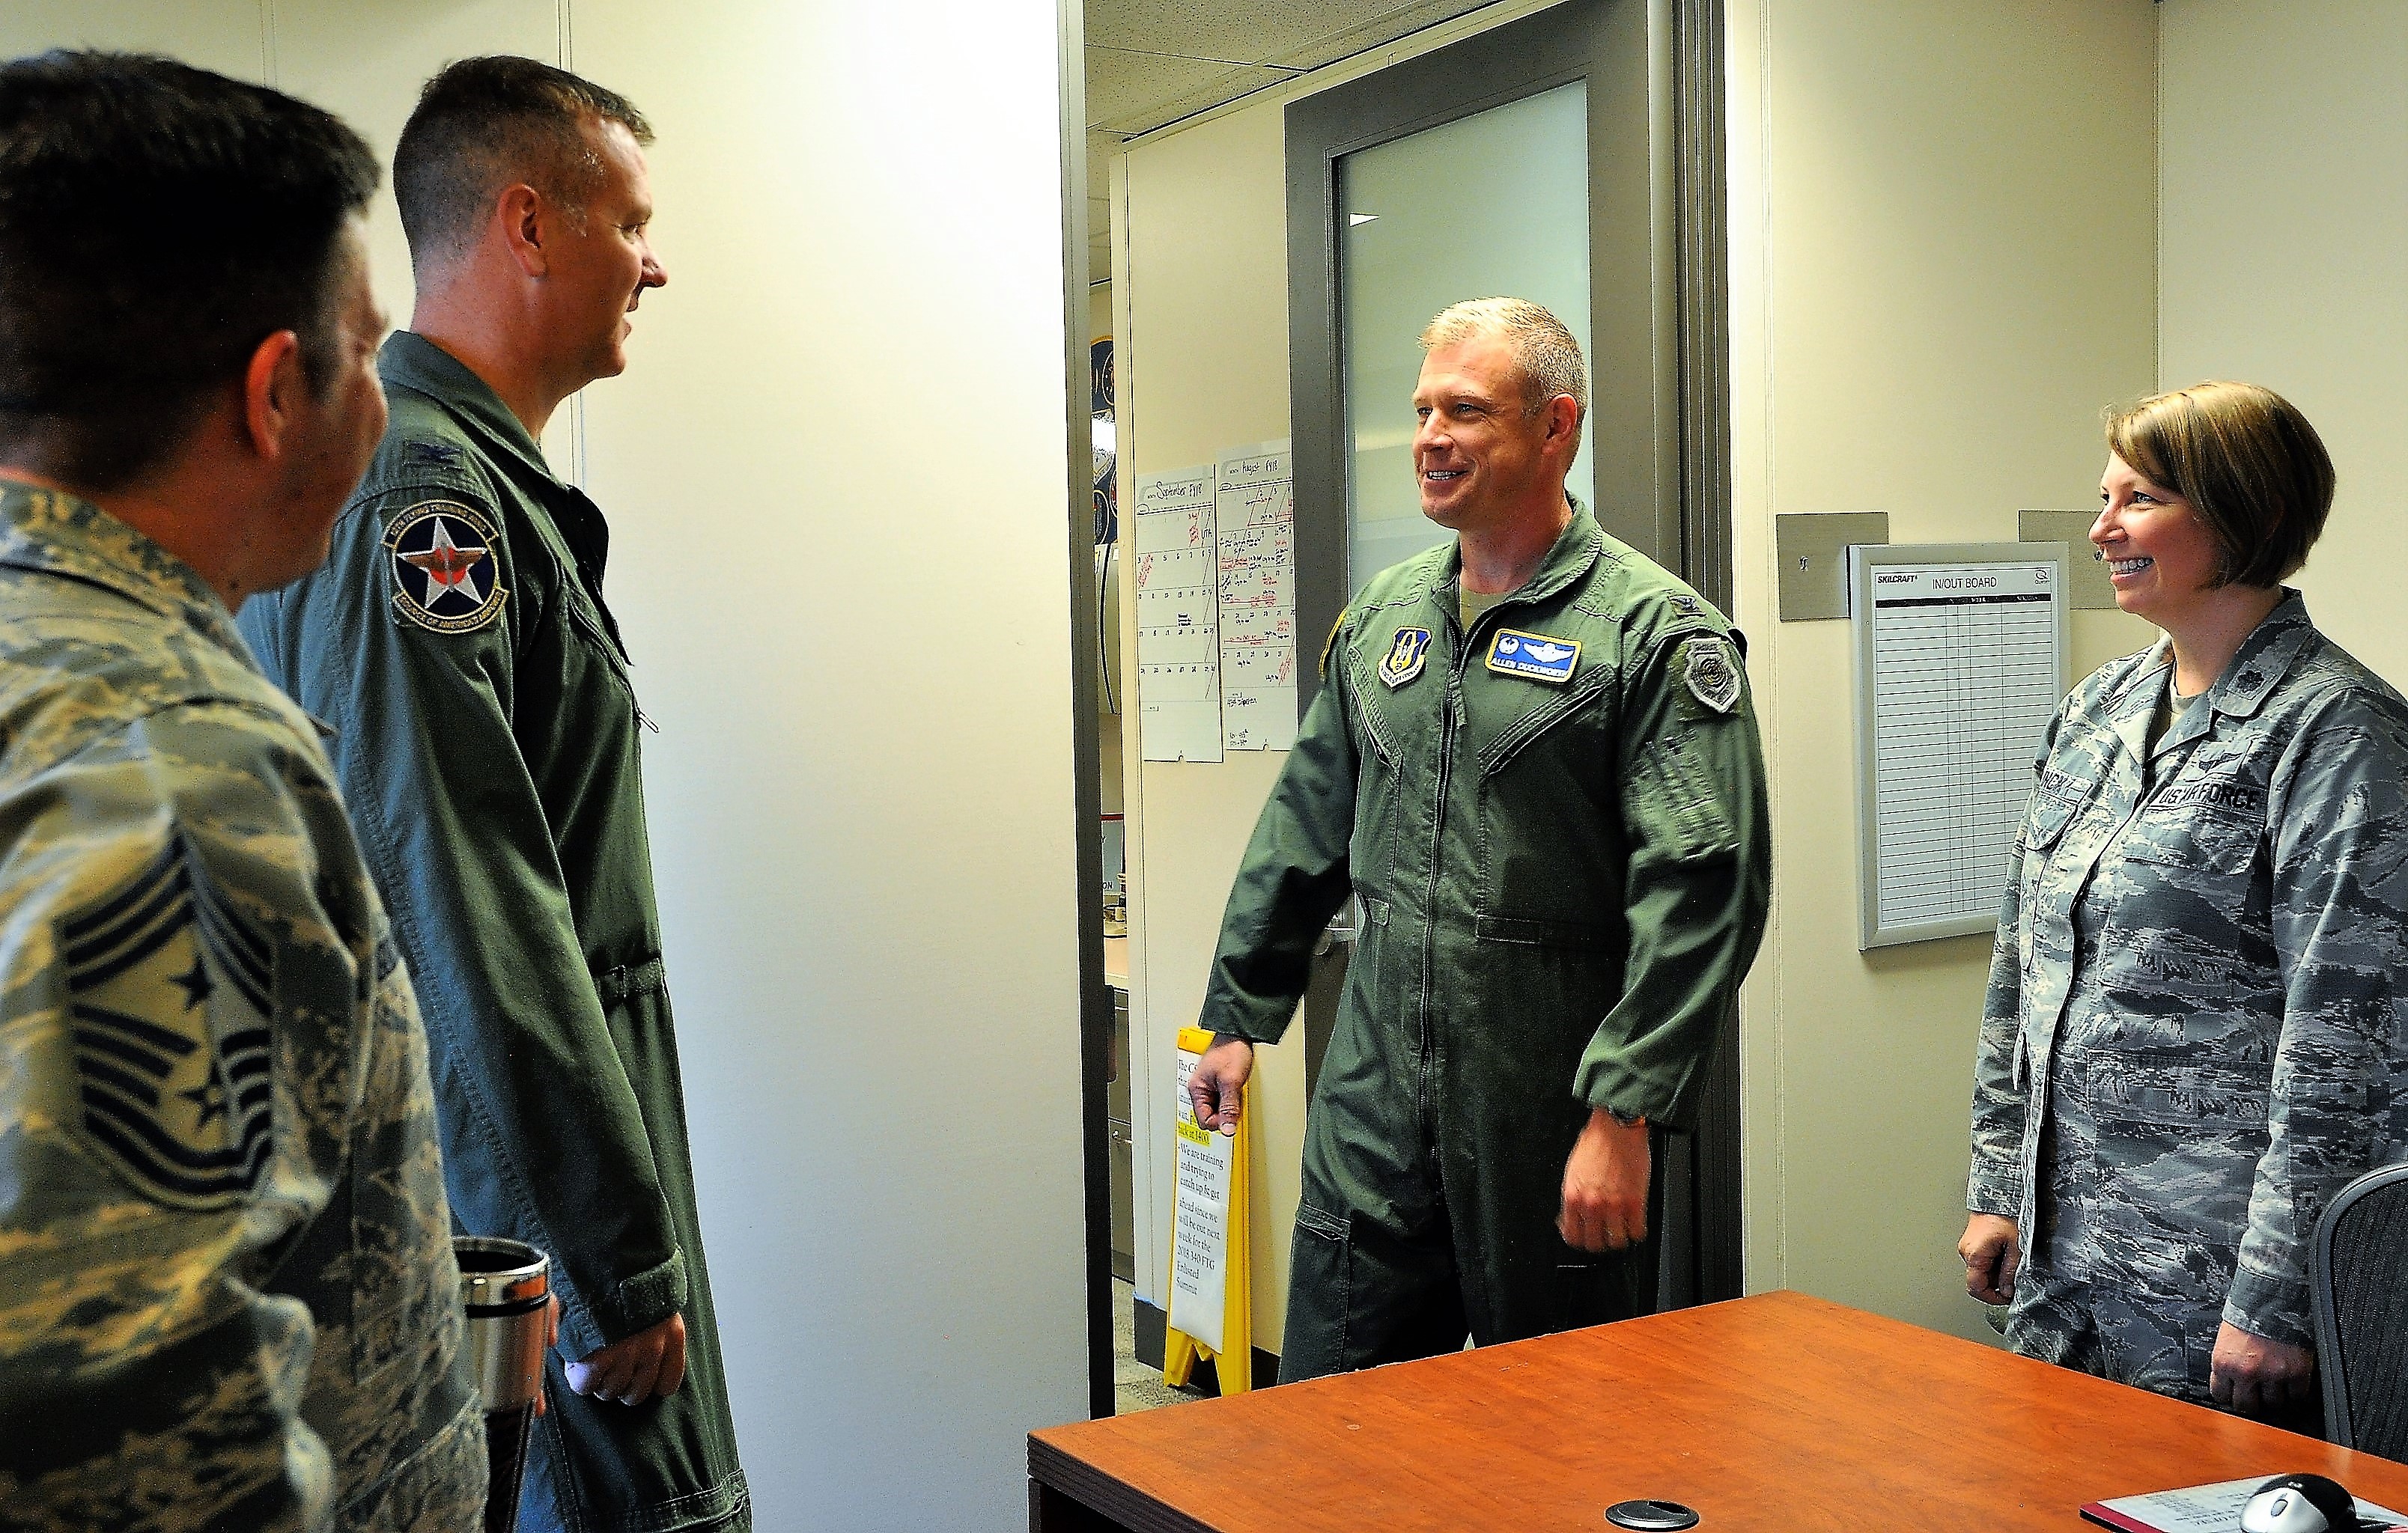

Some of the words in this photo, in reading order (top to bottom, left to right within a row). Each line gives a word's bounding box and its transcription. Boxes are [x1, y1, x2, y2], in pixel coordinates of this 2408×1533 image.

[1933, 578, 1963, 589] IN/OUT
[1965, 577, 1997, 588] BOARD
[2201, 781, 2260, 810] FORCE
[1181, 1143, 1190, 1156] We
[1200, 1152, 1223, 1171] training
[1180, 1162, 1191, 1172] and
[1191, 1165, 1208, 1181] trying
[1180, 1177, 1195, 1189] catch
[1196, 1183, 1203, 1195] up
[1204, 1184, 1210, 1195] &
[1211, 1189, 1220, 1201] get
[1202, 1255, 1214, 1270] FTG
